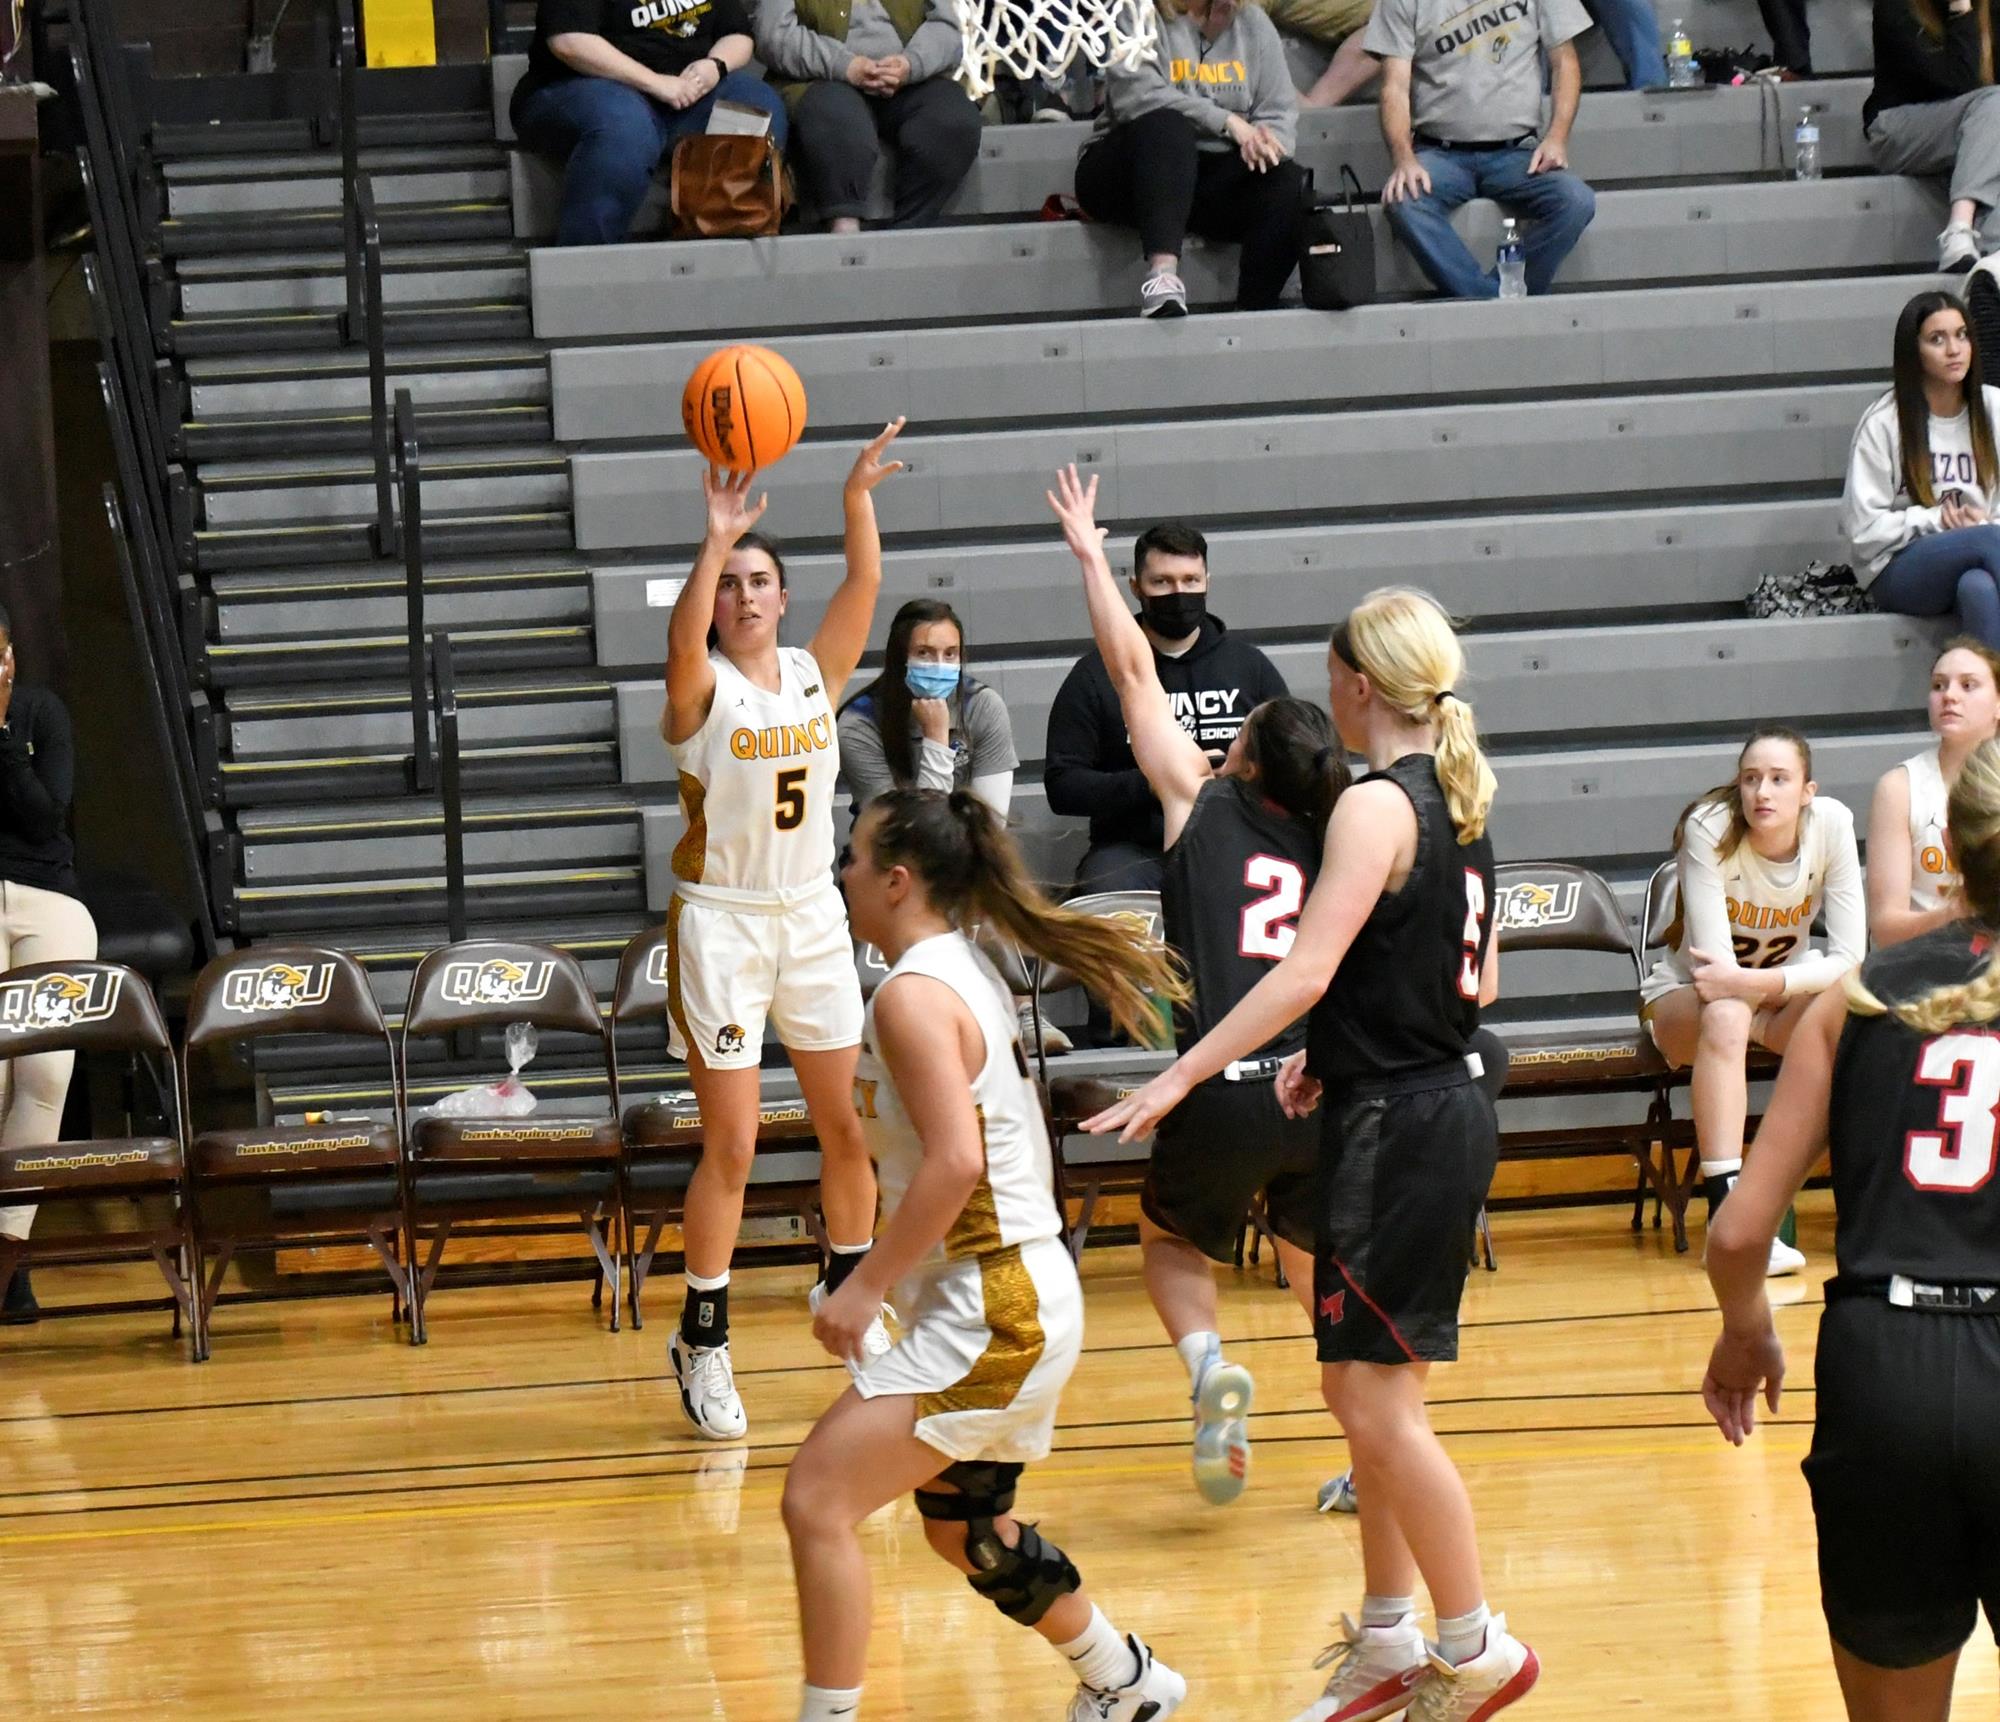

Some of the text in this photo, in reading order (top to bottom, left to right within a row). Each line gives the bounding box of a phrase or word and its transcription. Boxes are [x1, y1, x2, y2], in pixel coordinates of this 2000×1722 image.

[1434, 0, 1529, 55] QUINCY
[1168, 688, 1240, 717] INCY
[730, 712, 833, 761] QUINCY
[774, 766, 808, 832] 5
[1238, 852, 1307, 962] 2
[1731, 935, 1798, 970] 22
[1508, 1045, 1638, 1065] hawks.quincy.edu
[1903, 1028, 2000, 1193] 3
[236, 1134, 370, 1156] hawks.quincy.edu
[460, 1126, 594, 1142] hawks.quincy.edu
[14, 1149, 149, 1171] hawks.quincy.edu
